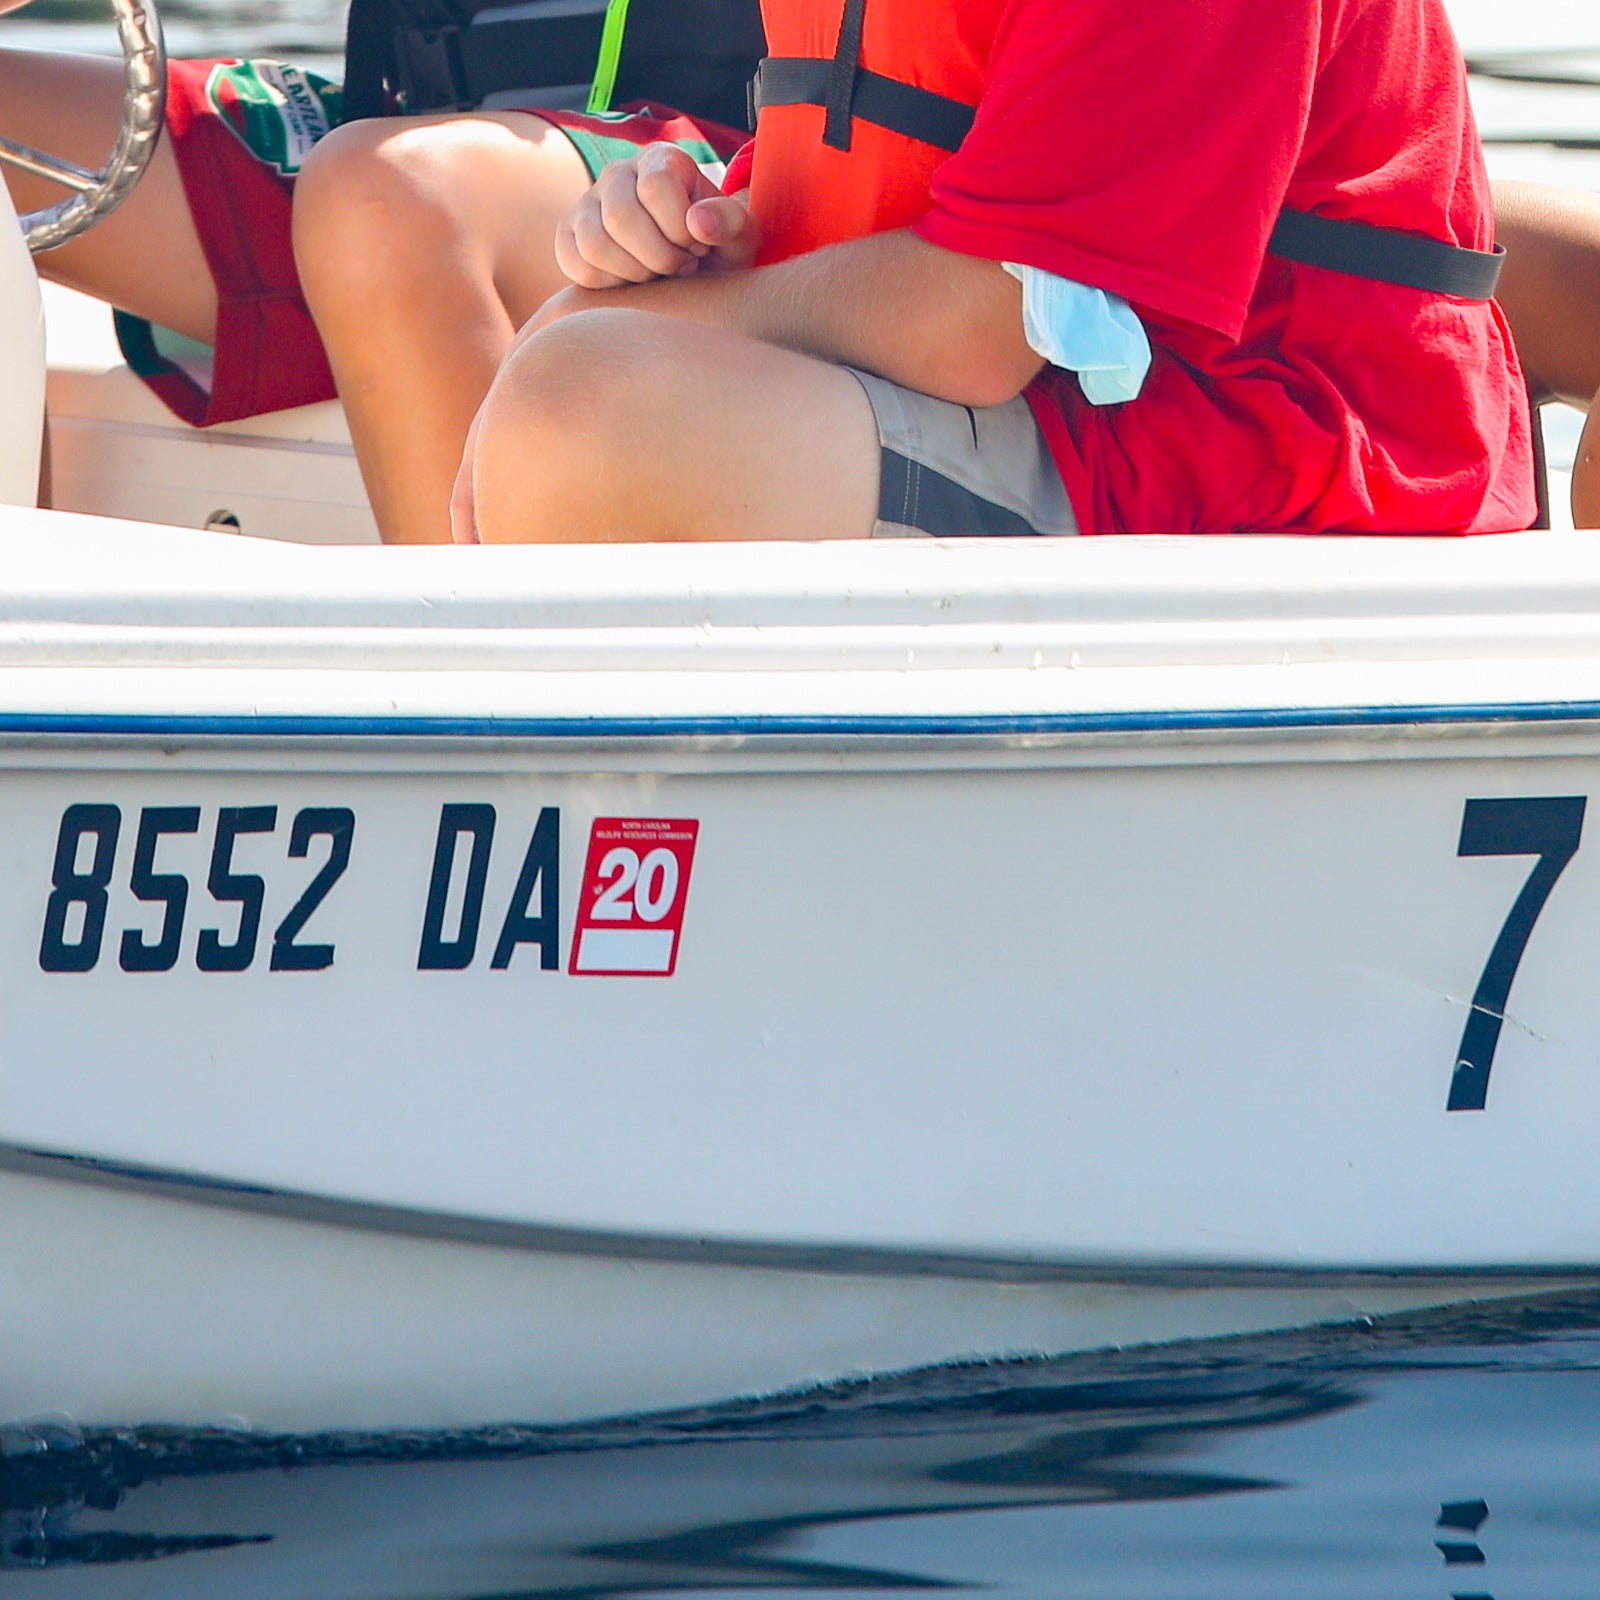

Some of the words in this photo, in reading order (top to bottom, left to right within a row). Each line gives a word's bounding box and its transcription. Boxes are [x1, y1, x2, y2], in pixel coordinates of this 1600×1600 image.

[39, 803, 356, 974] 8552
[416, 803, 560, 971] DA
[590, 847, 679, 922] 20
[1446, 796, 1587, 1112] 7
